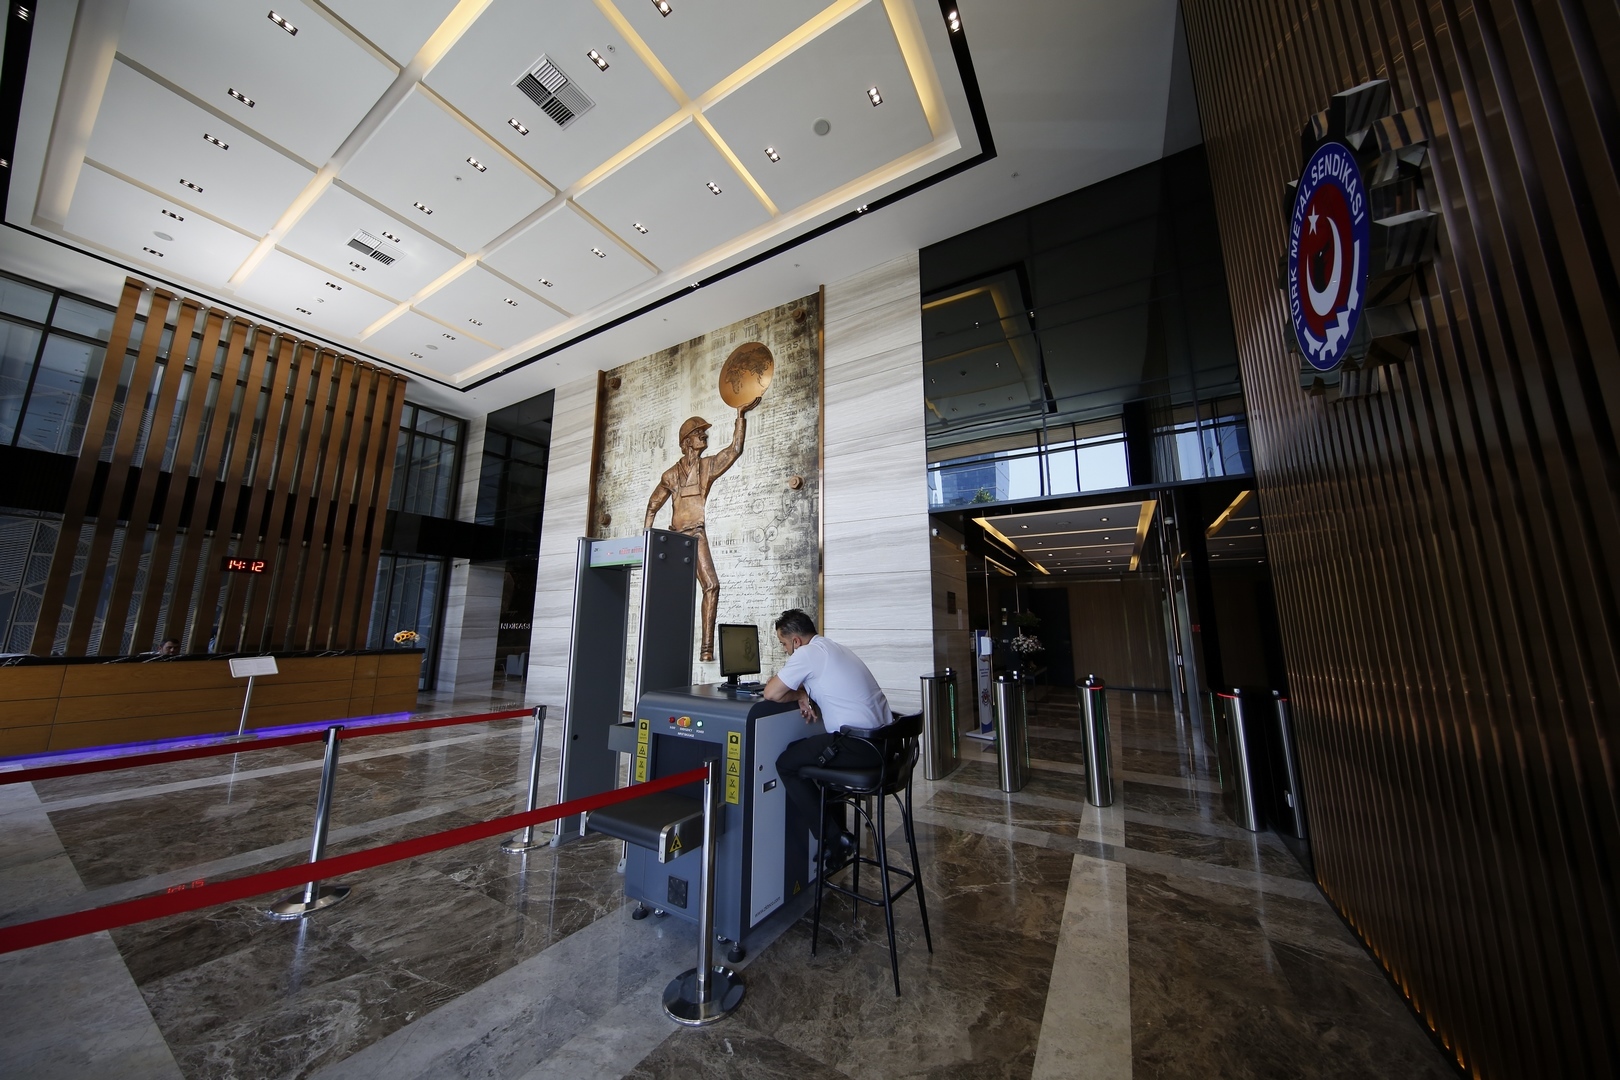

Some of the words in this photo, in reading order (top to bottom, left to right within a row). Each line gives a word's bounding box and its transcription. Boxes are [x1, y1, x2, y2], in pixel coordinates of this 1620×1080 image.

[1291, 184, 1311, 258] METAL
[1311, 152, 1364, 226] SENDİKASI
[1290, 266, 1303, 330] TÜRK
[228, 560, 265, 572] 14:12
